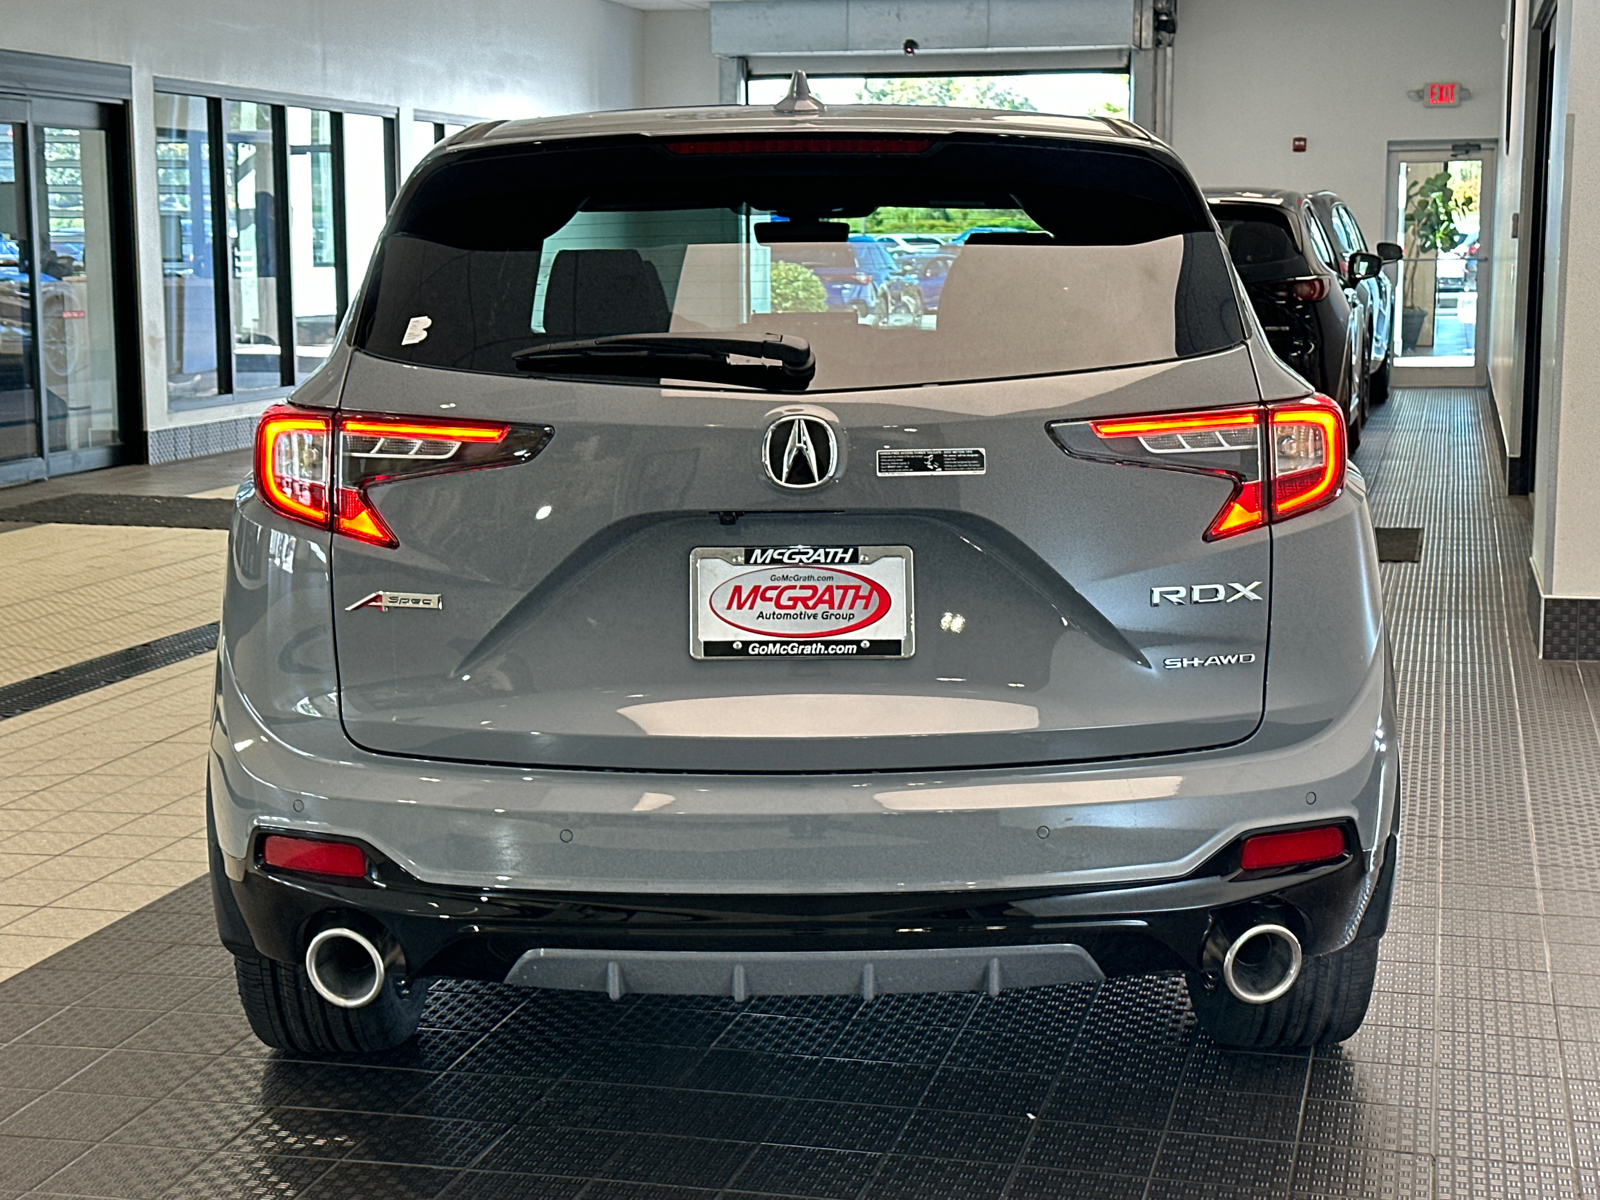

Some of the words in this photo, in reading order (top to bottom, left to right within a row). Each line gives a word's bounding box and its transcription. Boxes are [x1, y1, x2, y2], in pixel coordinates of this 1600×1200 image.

[1429, 83, 1456, 104] EXIT
[749, 548, 854, 564] McGRATH
[769, 574, 834, 582] GoMcGrath.com
[725, 585, 876, 611] McGRATH
[1150, 581, 1263, 607] RDX
[756, 611, 819, 620] Automotive
[821, 611, 855, 622] Group
[748, 643, 858, 655] GoMcGrath.com
[1163, 653, 1256, 670] SH-AWD
